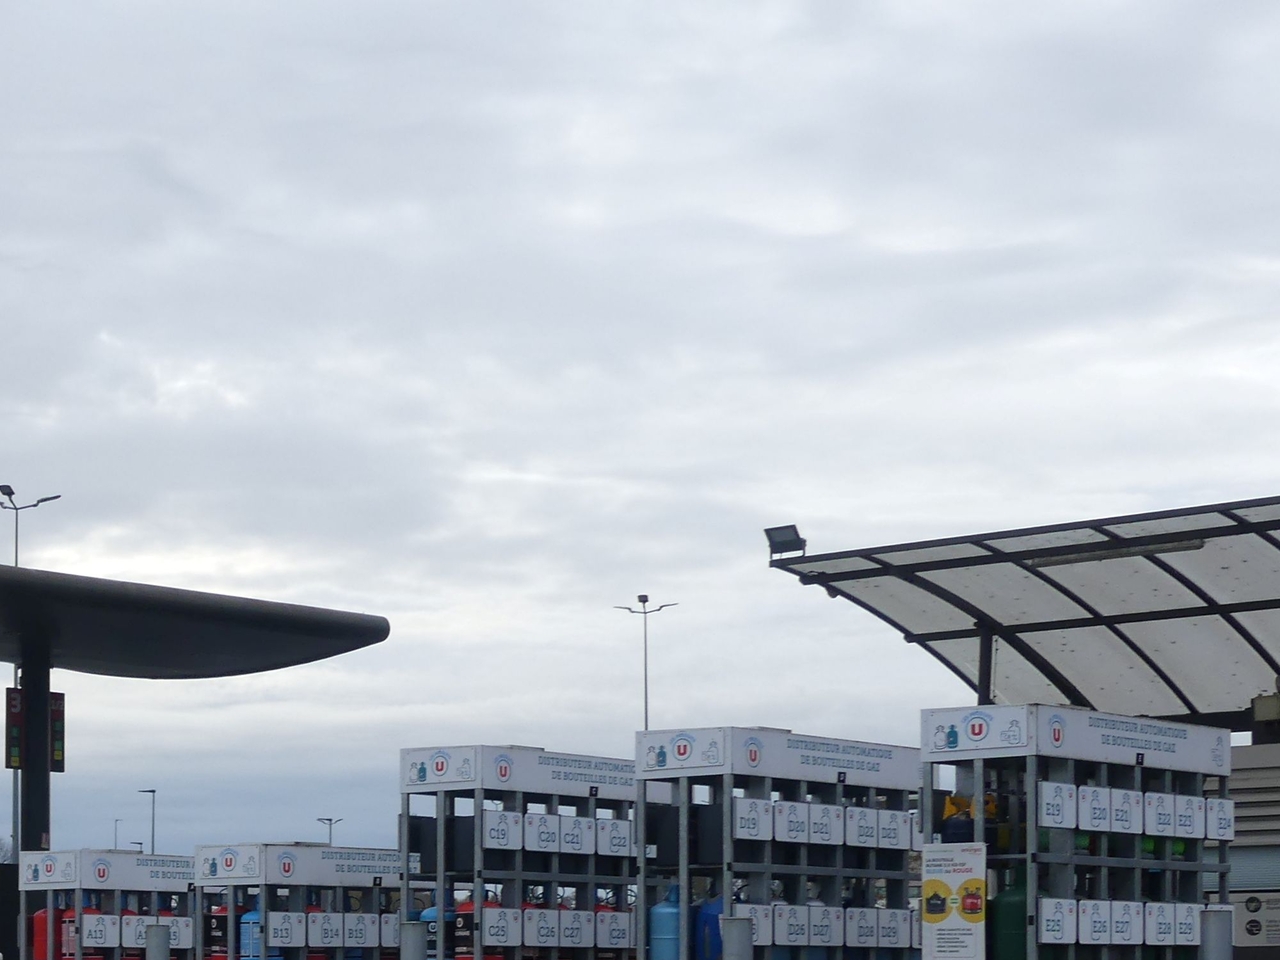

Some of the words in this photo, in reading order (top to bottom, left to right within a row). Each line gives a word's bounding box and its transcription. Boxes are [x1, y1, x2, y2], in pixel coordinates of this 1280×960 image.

[10, 692, 21, 713] 3
[971, 723, 983, 737] U
[1088, 716, 1139, 734] DISTRIBUTEUR
[1140, 724, 1188, 740] AUTOMATIQUE
[1053, 728, 1061, 742] U
[787, 739, 840, 754] DISTRIBUTEUR
[842, 745, 893, 759] AUTOMATIQUE
[1101, 734, 1111, 745] DE
[1112, 735, 1152, 750] BOUTEILLES
[1153, 741, 1162, 751] DE
[1163, 742, 1176, 753] GAZ
[677, 744, 688, 757] U
[749, 749, 758, 762] U
[435, 761, 445, 772] U
[538, 756, 592, 769] DISTRIBUTEUR
[801, 755, 811, 765] DE
[812, 756, 855, 769] BOUTEILLES
[856, 760, 866, 770] DE
[867, 762, 880, 773] GAZ
[500, 765, 508, 777] U
[551, 770, 562, 780] DE
[563, 772, 607, 784] BOUTEILLES
[608, 776, 618, 786] DE
[620, 777, 634, 787] GAZ
[1045, 802, 1061, 817] E19
[1092, 807, 1107, 821] E20
[1115, 808, 1129, 822] E21
[739, 816, 757, 830] D19
[1158, 812, 1171, 826] E22
[1178, 814, 1192, 827] E23
[1218, 817, 1231, 830] E24
[788, 820, 806, 833] D20
[812, 822, 829, 835] D21
[858, 825, 874, 838] D22
[489, 828, 506, 840] C19
[538, 831, 556, 843] C20
[564, 833, 580, 844] C21
[881, 827, 897, 839] D23
[611, 836, 627, 847] C22
[224, 857, 233, 868] U
[322, 851, 376, 862] DISTRIBUTEUR
[45, 863, 53, 873] U
[136, 858, 190, 869] DISTRIBUTEUR
[283, 862, 291, 873] U
[335, 864, 345, 873] DE
[347, 864, 391, 874] BOUTEILLES
[97, 867, 106, 879] U
[150, 870, 160, 879] DE
[488, 925, 506, 937] C25
[788, 924, 806, 936] D26
[812, 924, 829, 936] D27
[1045, 918, 1061, 932] E25
[1093, 920, 1107, 933] E26
[1115, 920, 1130, 934] E27
[1178, 922, 1192, 935] E29
[86, 929, 104, 940] A13
[273, 928, 289, 939] B13
[323, 928, 339, 939] B14
[348, 928, 364, 939] B15
[538, 926, 555, 938] C26
[563, 927, 580, 938] C27
[610, 928, 627, 939] C28
[881, 926, 897, 938] D29
